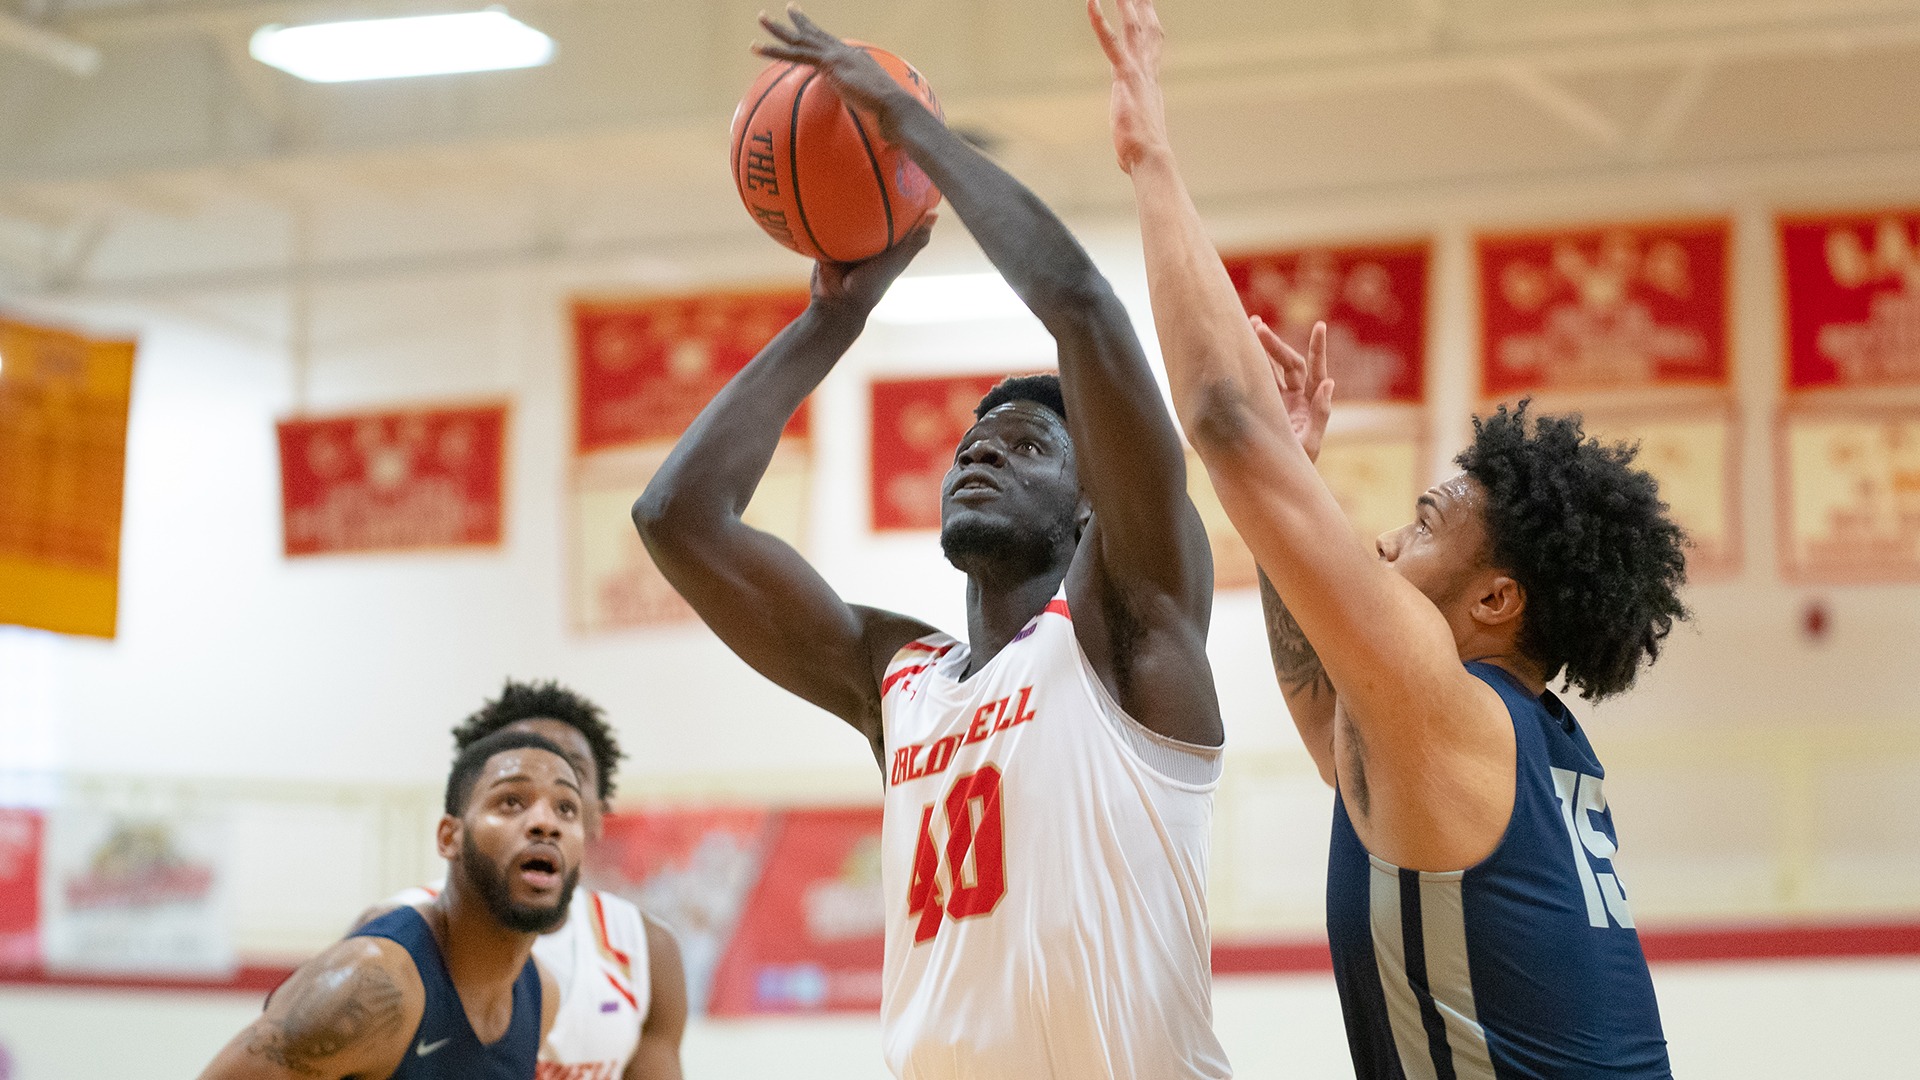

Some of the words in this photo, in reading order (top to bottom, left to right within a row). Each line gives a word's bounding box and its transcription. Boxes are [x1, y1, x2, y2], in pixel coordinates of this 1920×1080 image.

[747, 129, 780, 196] THE
[891, 685, 1036, 787] CALDELL
[907, 760, 1008, 947] 40
[1549, 766, 1636, 929] 15
